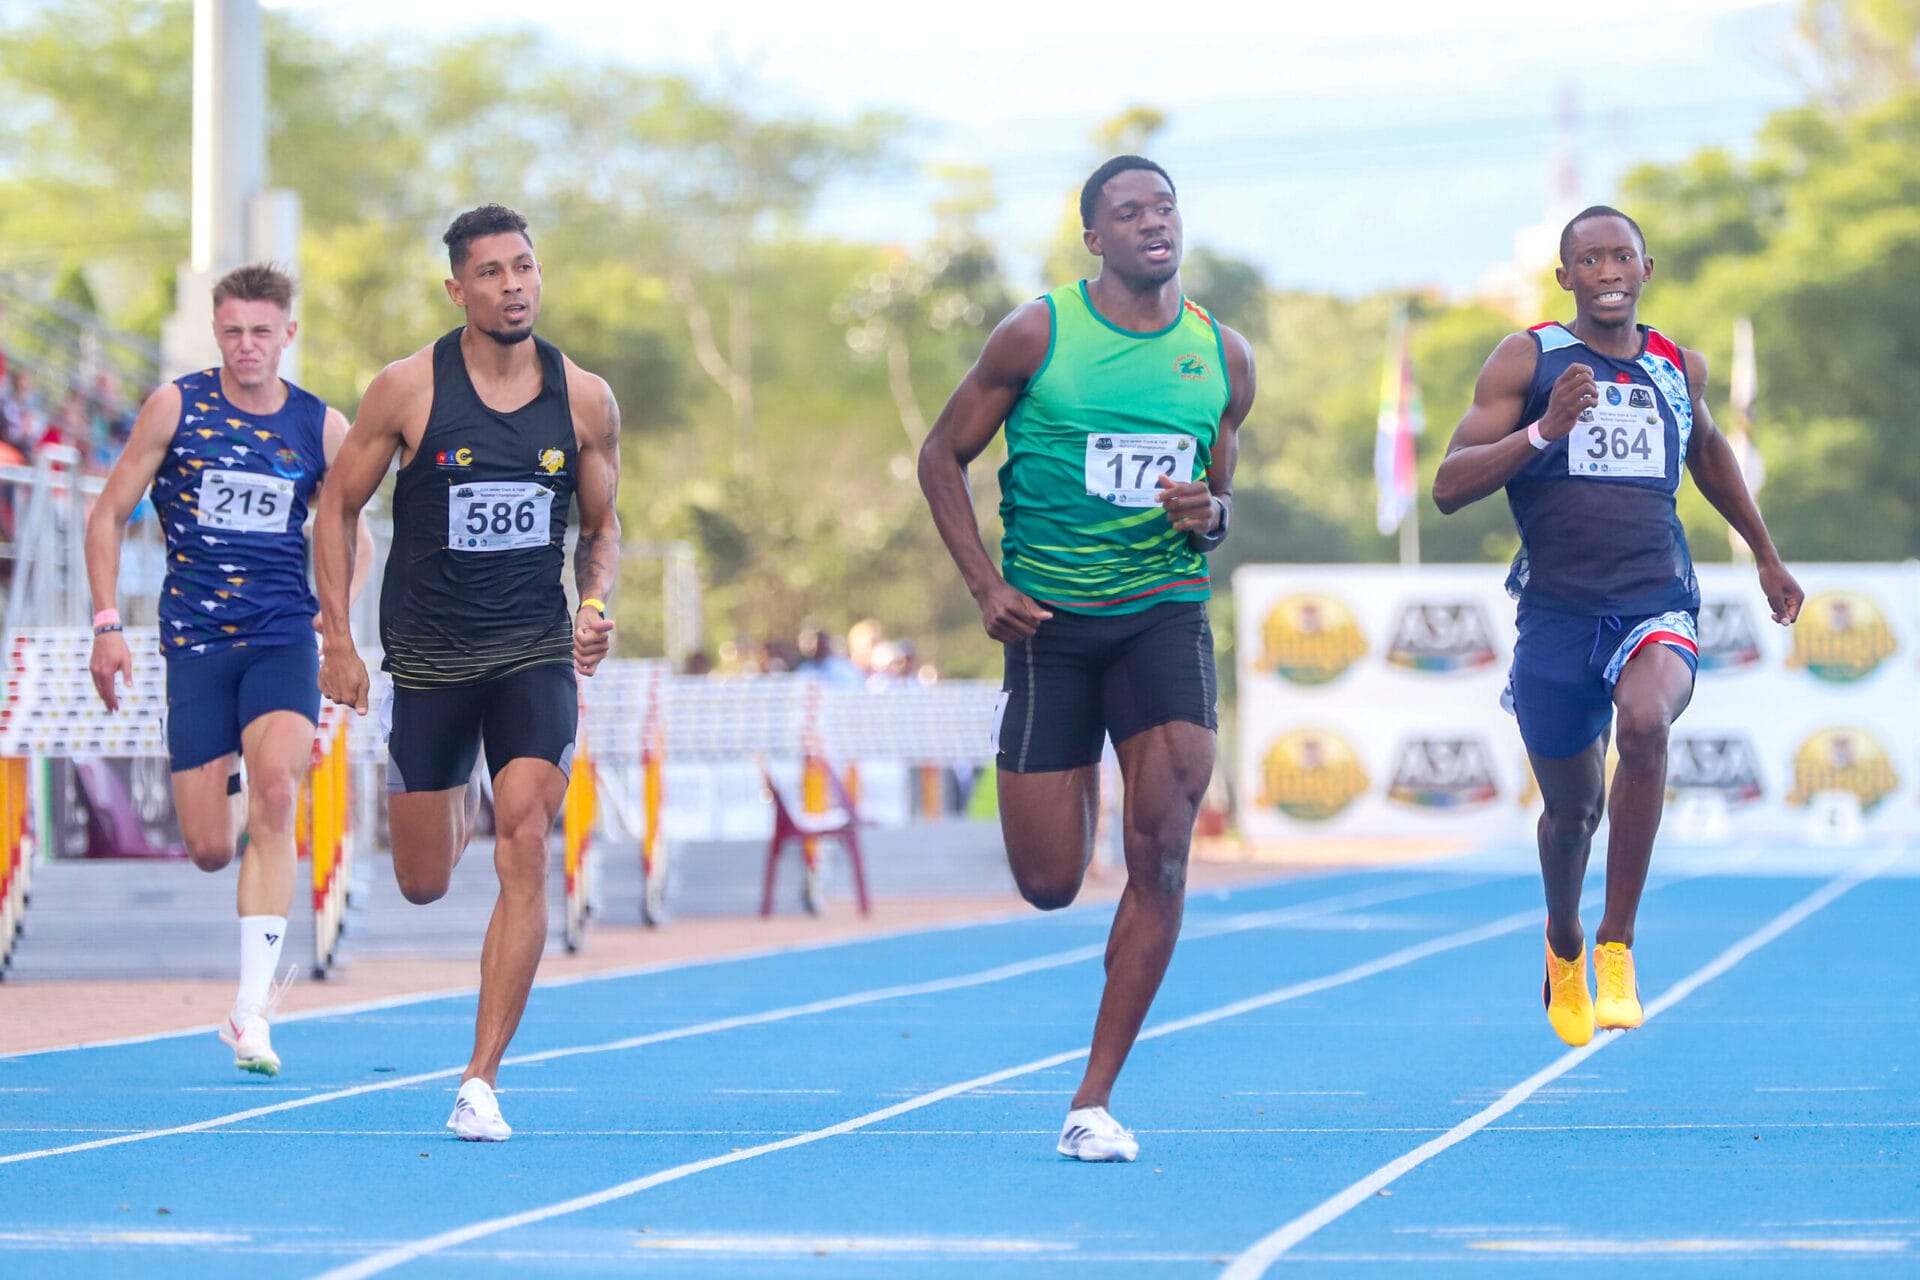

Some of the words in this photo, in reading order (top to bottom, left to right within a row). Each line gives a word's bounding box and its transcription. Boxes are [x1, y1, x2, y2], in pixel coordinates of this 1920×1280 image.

[1631, 390, 1651, 401] ASA
[1586, 425, 1652, 460] 364
[1107, 453, 1176, 489] 172
[214, 487, 277, 517] 215
[466, 501, 535, 535] 586
